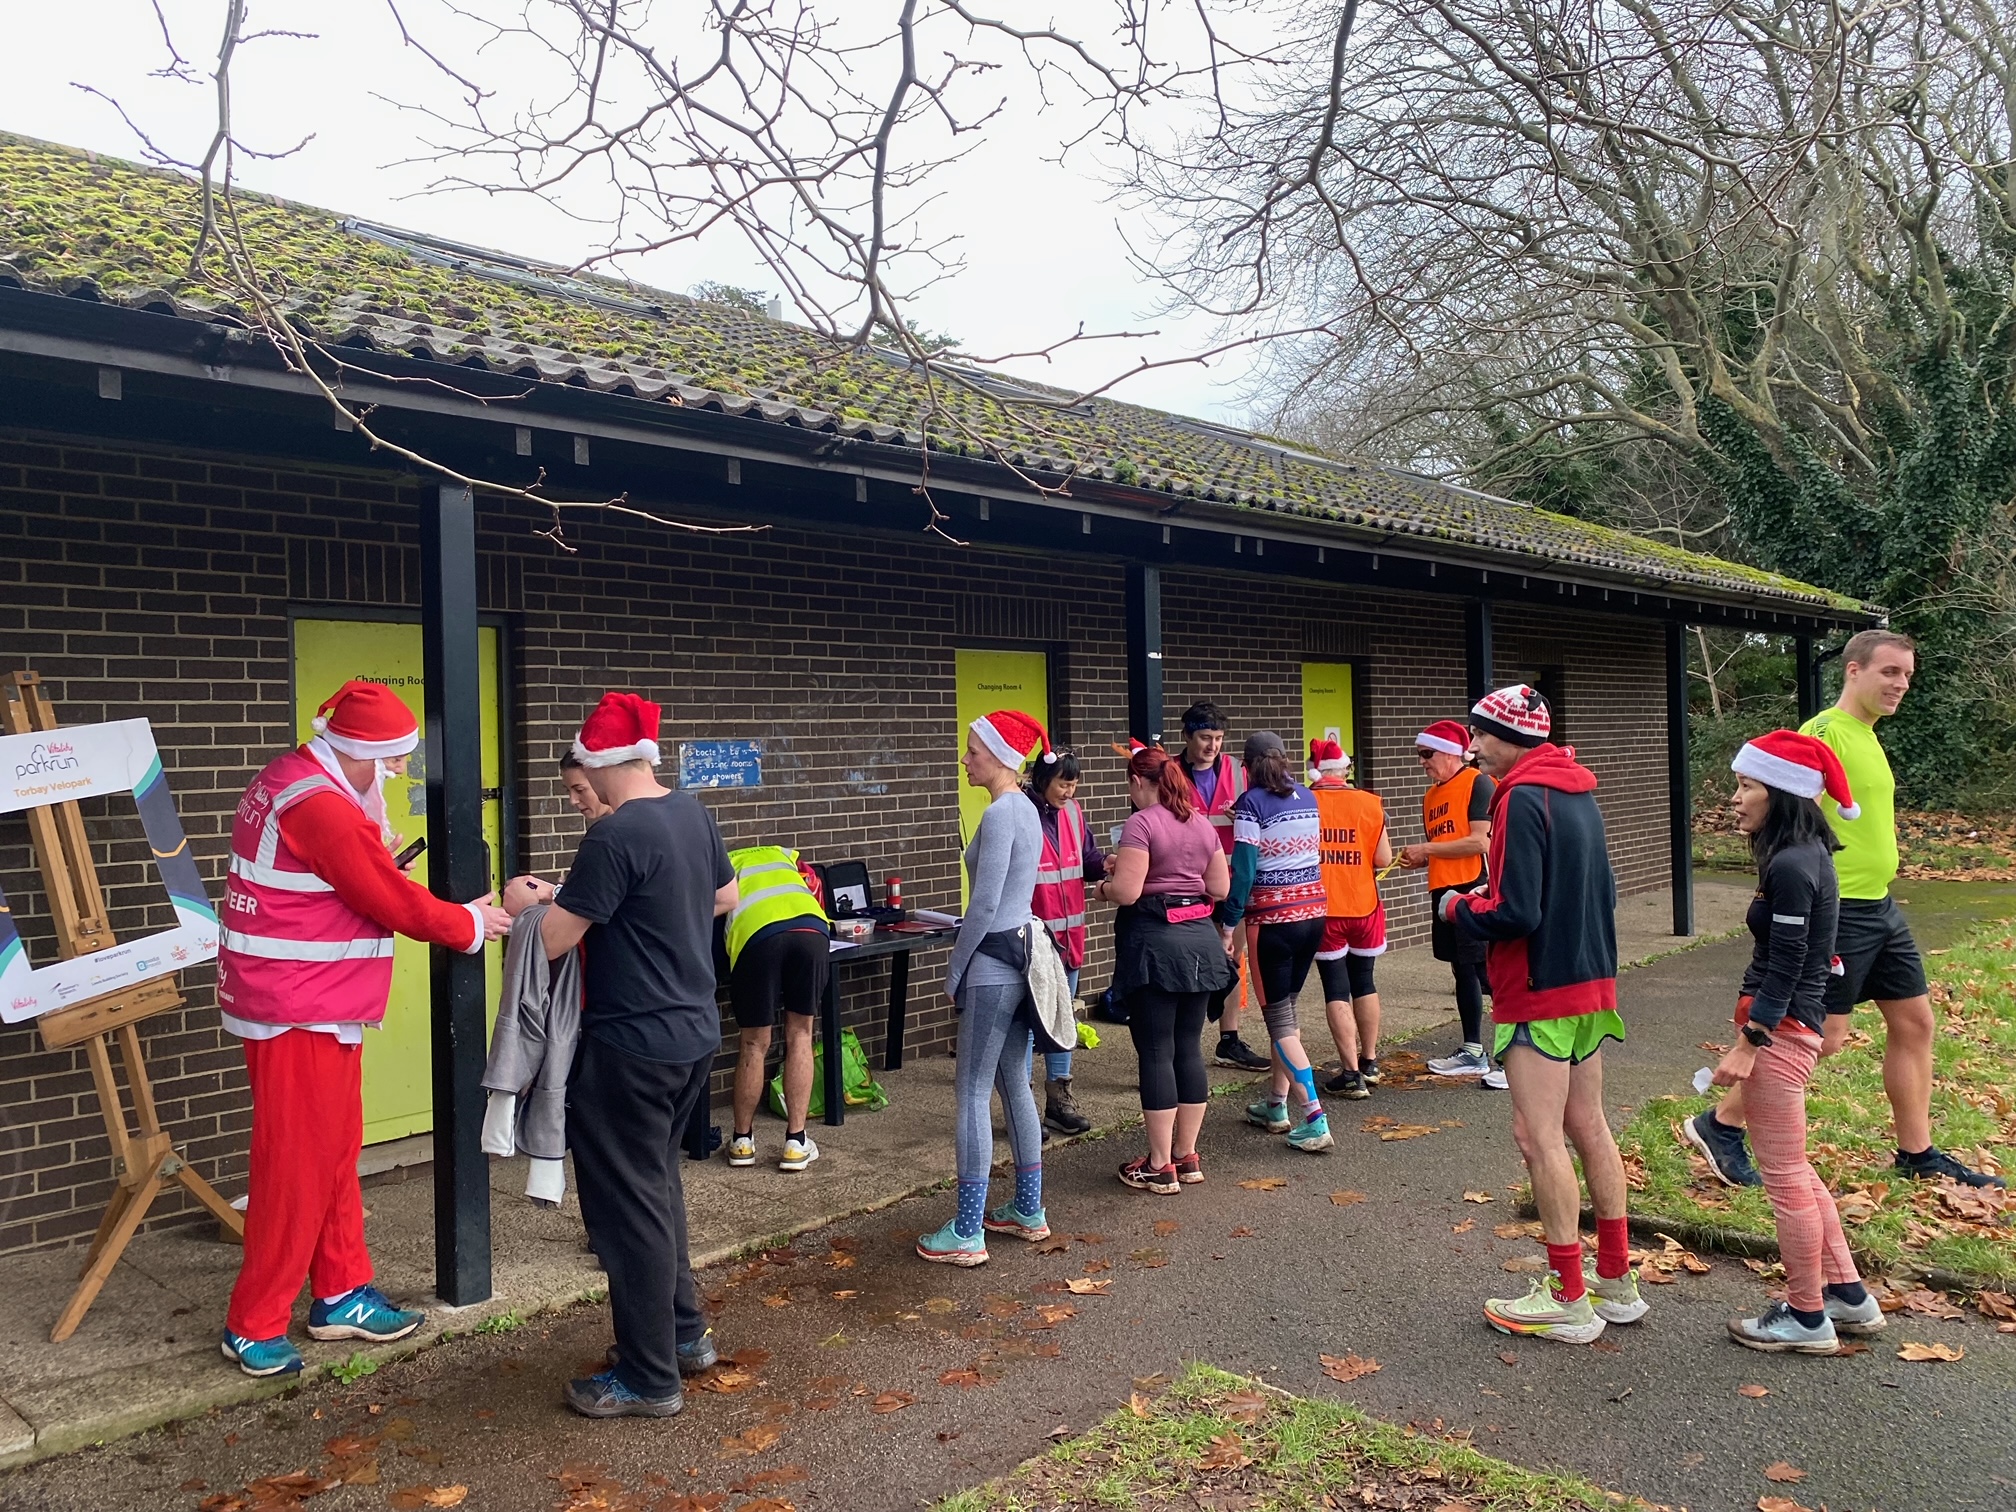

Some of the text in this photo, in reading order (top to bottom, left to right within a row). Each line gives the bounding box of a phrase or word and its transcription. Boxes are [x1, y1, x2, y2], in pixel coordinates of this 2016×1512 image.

[355, 675, 405, 687] Changing
[977, 683, 1002, 692] Changing
[1003, 683, 1018, 691] Room
[46, 742, 74, 754] Vitality
[15, 744, 79, 780] parkrun
[13, 777, 92, 798] Torbay Velopark
[1428, 801, 1449, 822] BLIND
[1318, 850, 1362, 866] UNNER
[94, 948, 132, 963] #loveparkrun
[11, 996, 37, 1010] Vitality
[957, 1240, 975, 1250] HOKA
